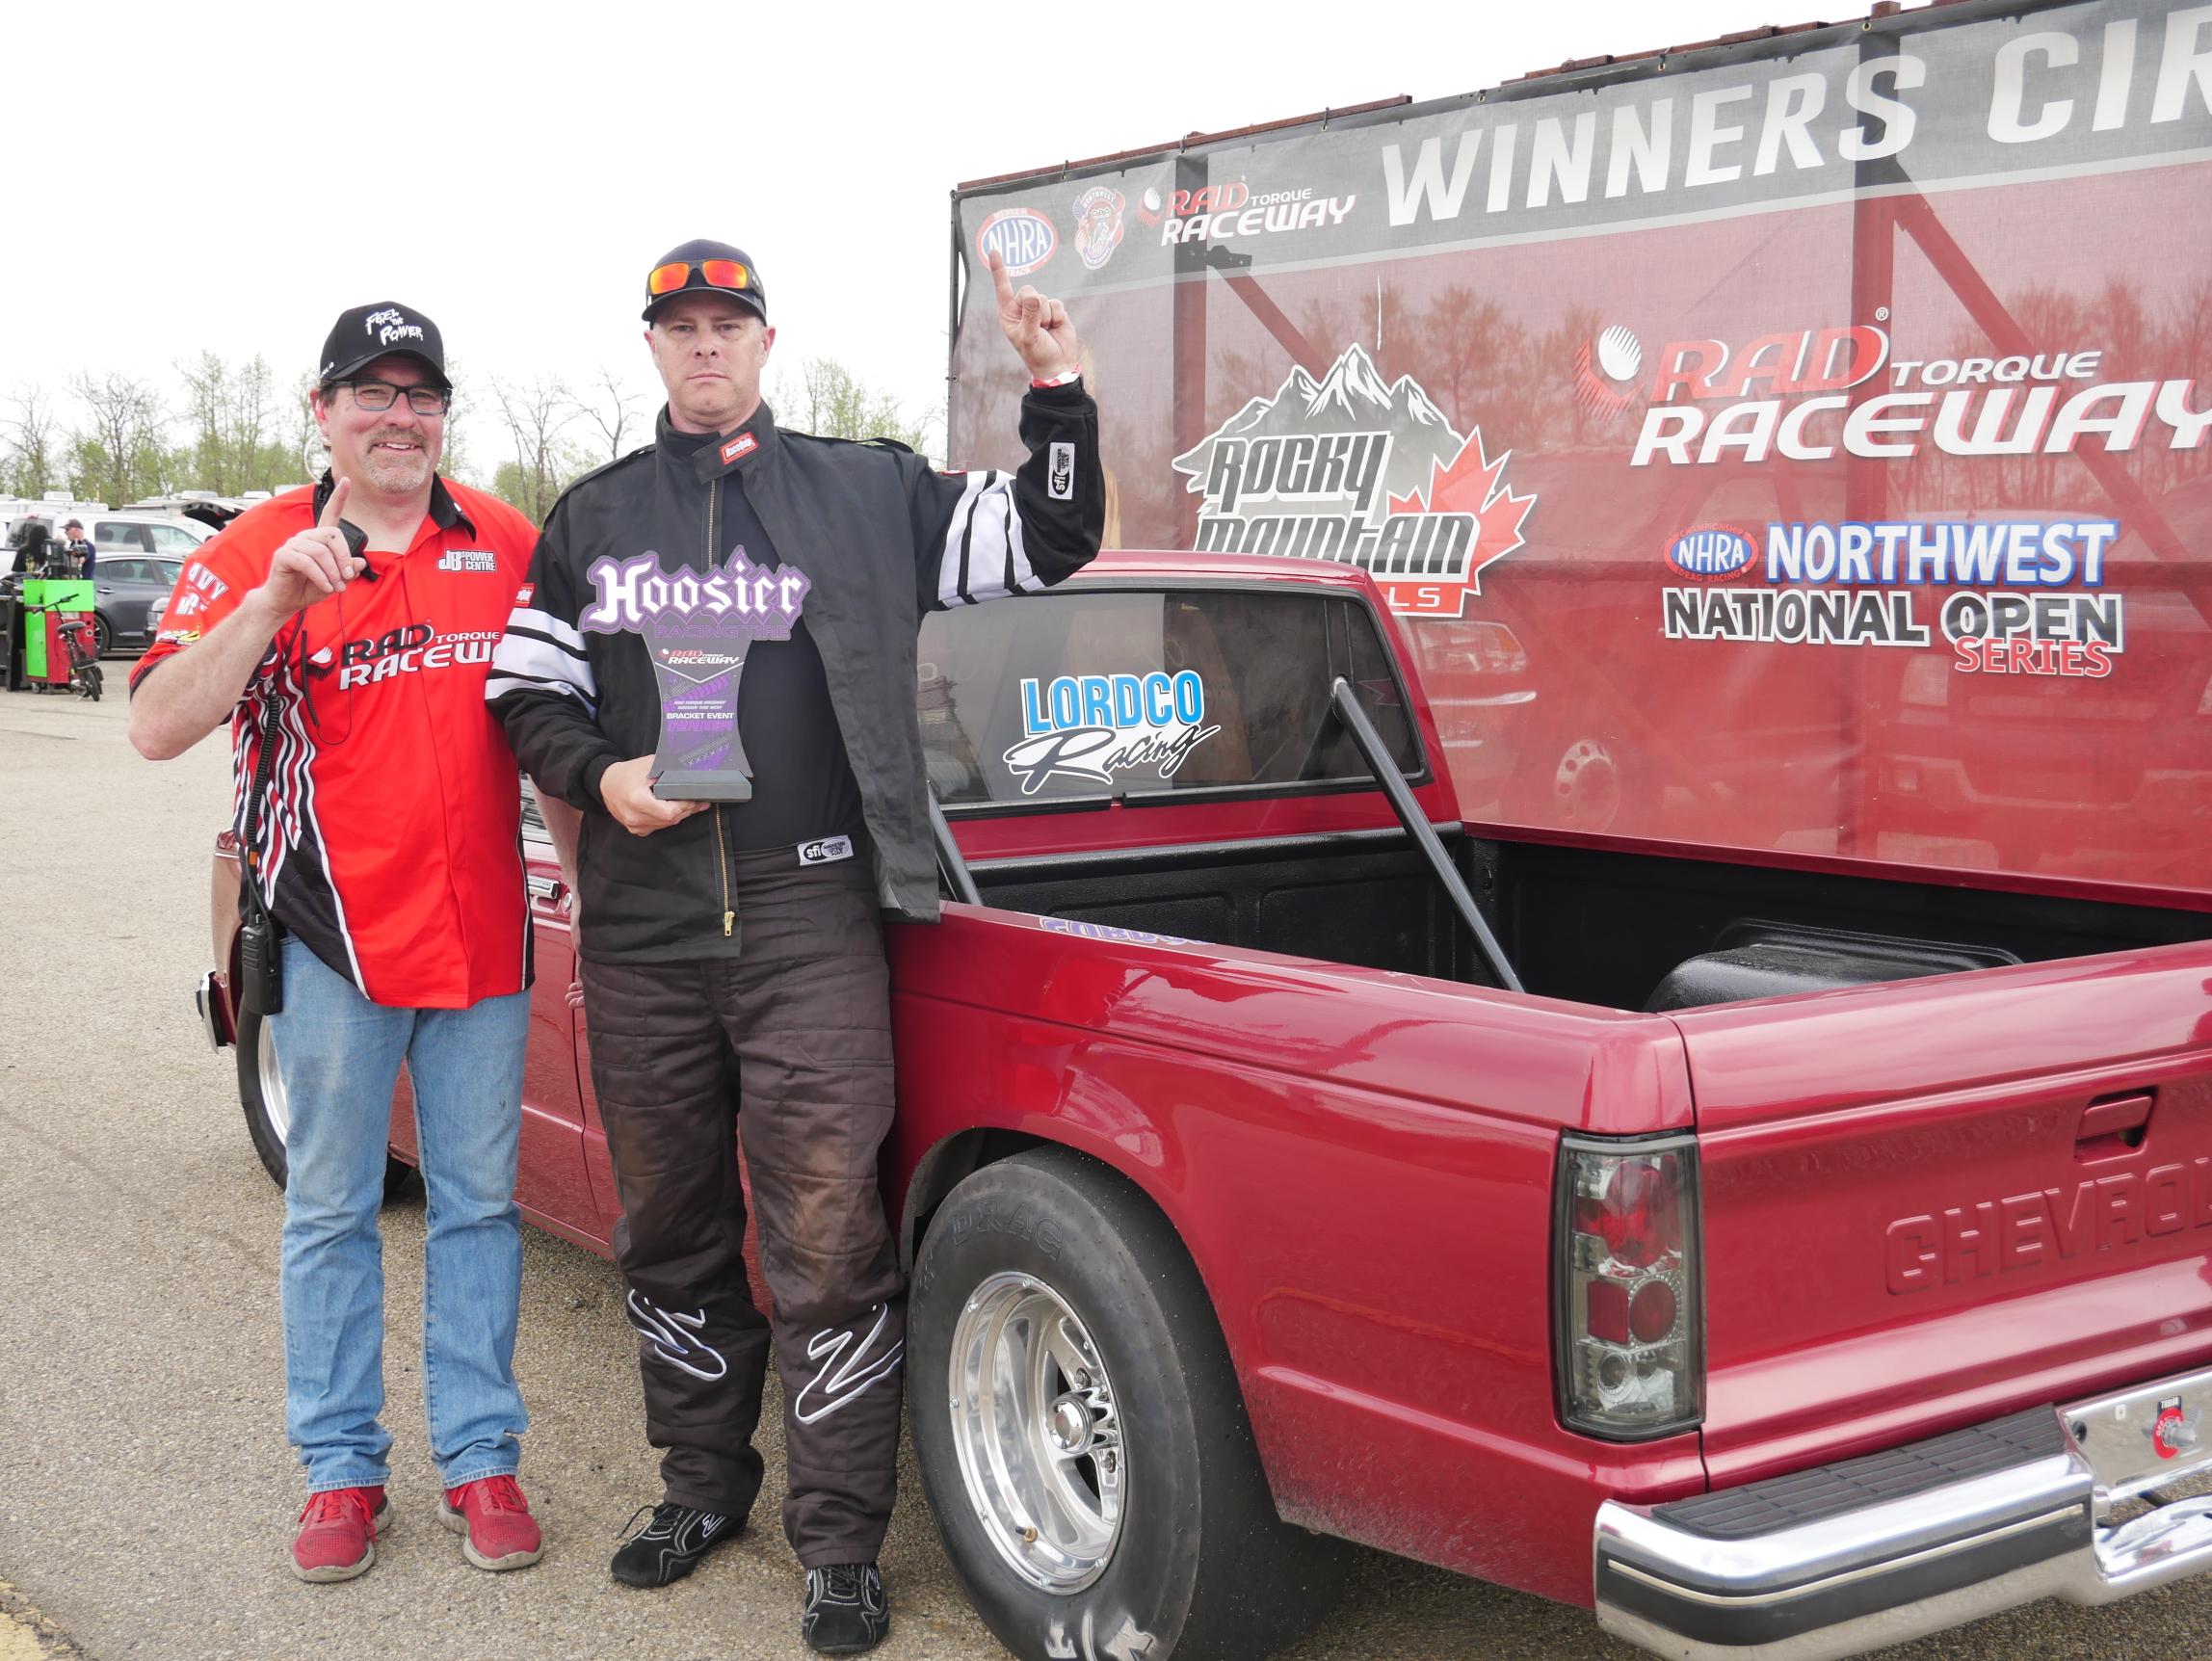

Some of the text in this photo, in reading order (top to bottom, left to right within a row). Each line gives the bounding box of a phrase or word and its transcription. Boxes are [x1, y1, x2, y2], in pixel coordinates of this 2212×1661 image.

[1382, 55, 1926, 226] WINNERS
[1160, 194, 1356, 247] RACEWAY
[1167, 181, 1313, 218] RAD TORQUE
[988, 219, 1048, 265] NHRA
[380, 326, 424, 346] POWER
[1649, 325, 2102, 402] RAD TORQUE
[1629, 379, 2212, 466] RACEWAY
[1204, 431, 1394, 515] ROCKY
[464, 550, 494, 562] POWER
[465, 561, 496, 571] CENTRE
[1677, 533, 1746, 572] NHRA
[1766, 522, 2118, 585] NORTHWEST
[586, 556, 804, 624] Hoosier
[654, 623, 791, 640] RACING TIRE
[1662, 587, 2125, 652] NATIONAL OPEN
[339, 641, 495, 691] RACEW
[340, 623, 500, 668] RAD TORQUE
[668, 656, 740, 665] RACEWAY
[1954, 635, 2112, 677] SERIES
[1020, 671, 1204, 738] LORDCO
[1003, 725, 1222, 795] Racing
